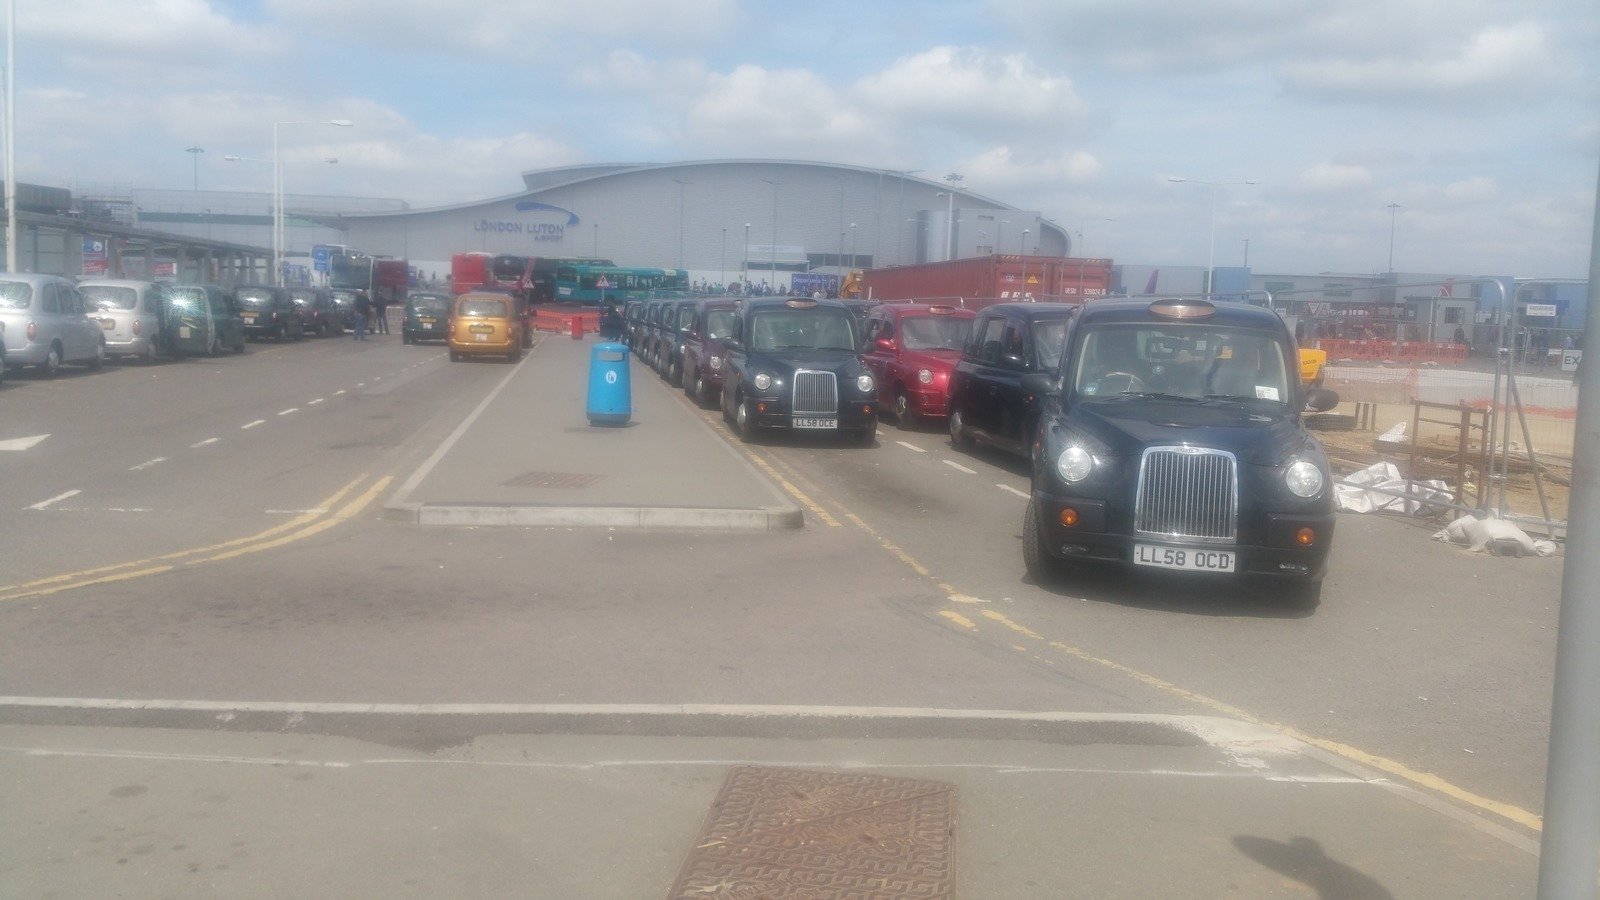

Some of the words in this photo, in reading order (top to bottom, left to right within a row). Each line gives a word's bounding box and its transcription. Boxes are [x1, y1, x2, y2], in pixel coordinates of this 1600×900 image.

[474, 220, 522, 233] LONDON
[526, 223, 564, 234] LUTON
[796, 418, 818, 427] LL58
[818, 419, 834, 428] OCE
[1140, 546, 1187, 566] LL58
[1194, 552, 1230, 569] OCD
